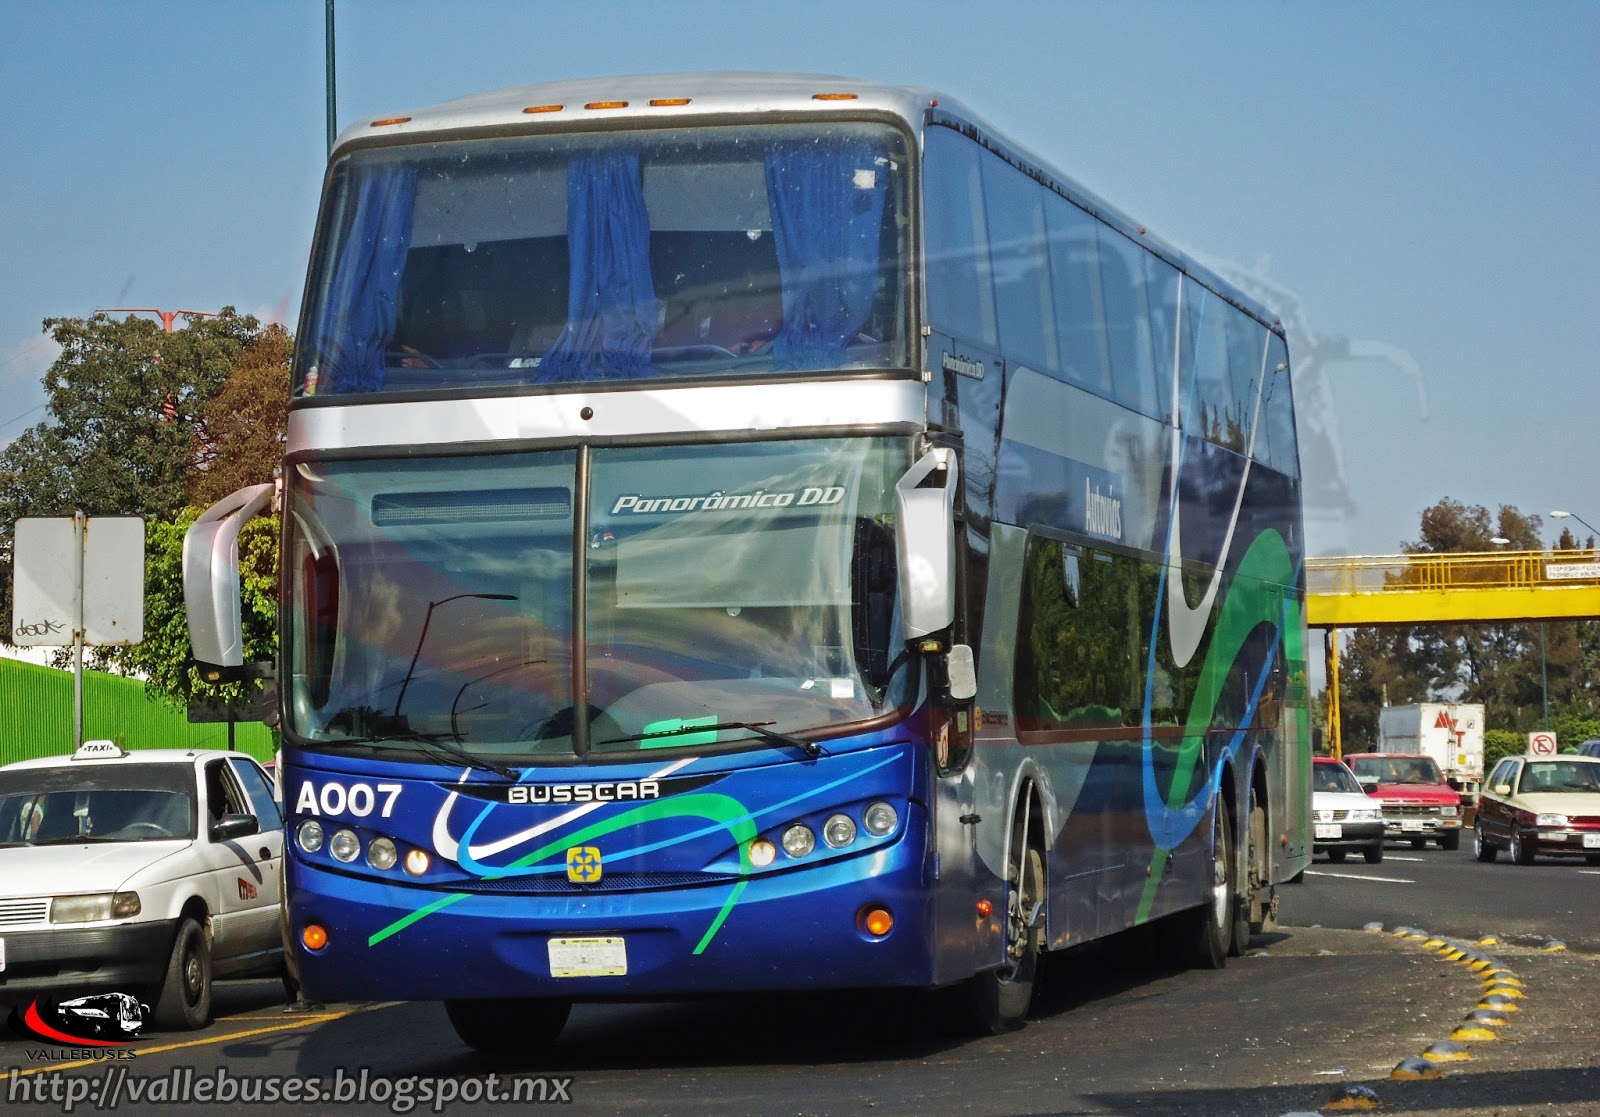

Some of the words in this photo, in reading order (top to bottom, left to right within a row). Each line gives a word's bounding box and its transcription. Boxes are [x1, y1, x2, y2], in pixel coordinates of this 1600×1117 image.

[612, 491, 794, 513] Panorâmico
[797, 486, 846, 506] DD
[296, 781, 402, 818] A007
[508, 782, 660, 804] BUSSCAR
